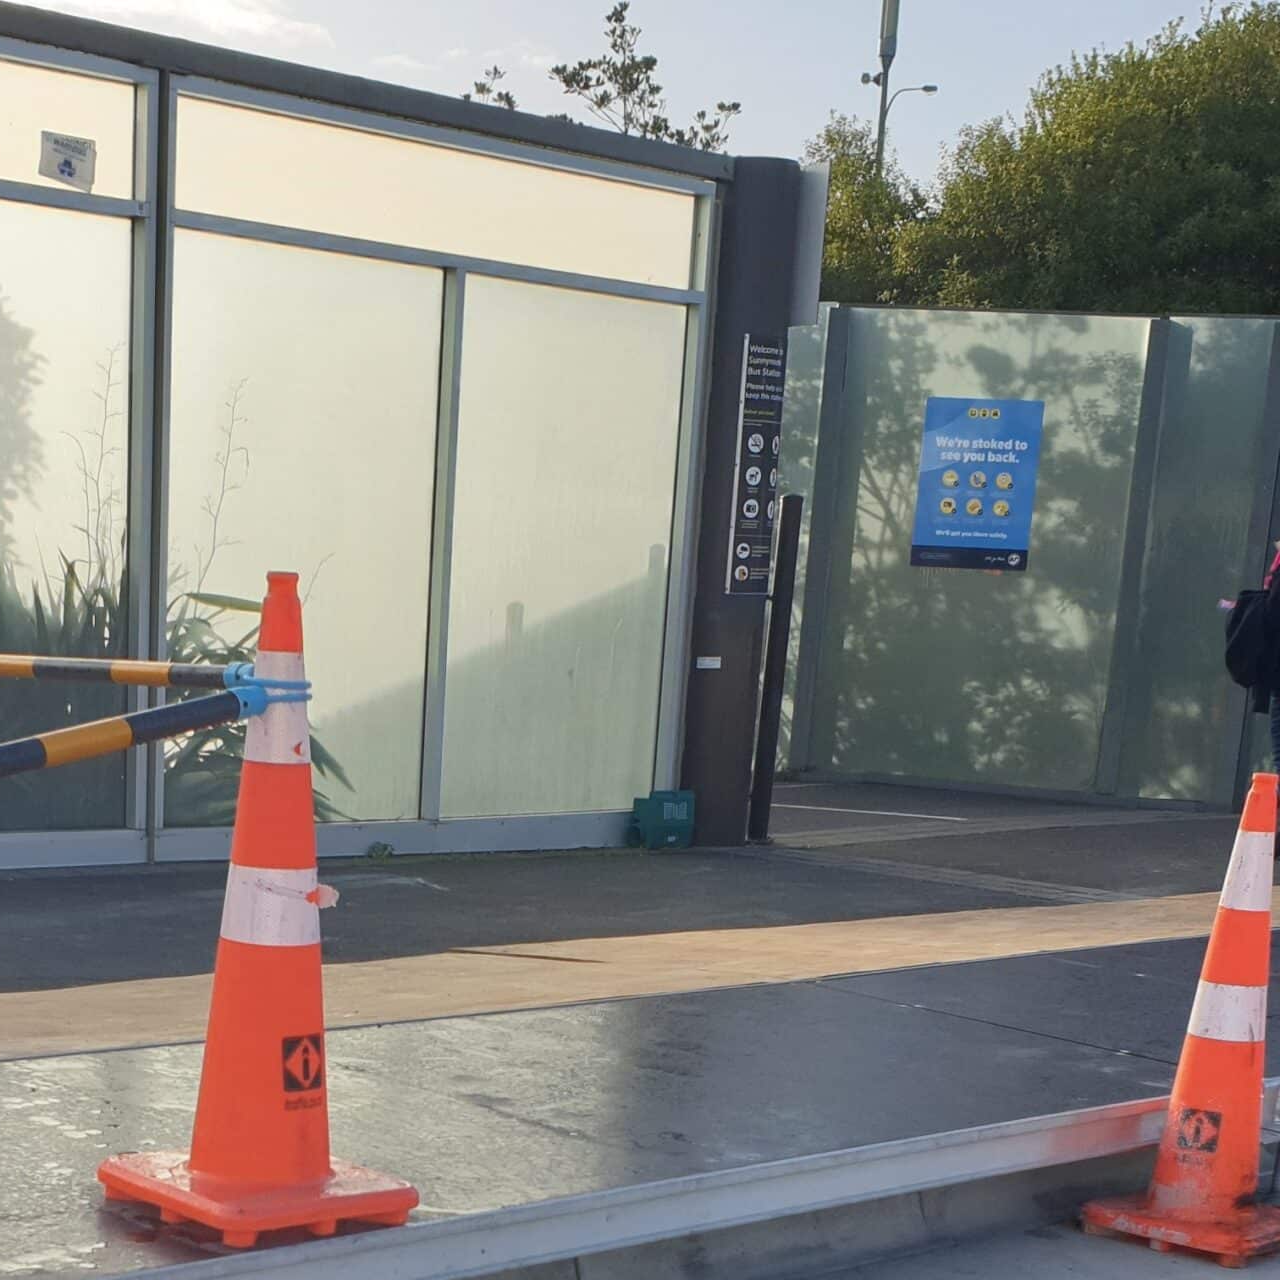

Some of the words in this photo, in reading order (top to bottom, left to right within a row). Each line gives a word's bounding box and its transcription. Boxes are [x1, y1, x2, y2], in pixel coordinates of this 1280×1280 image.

[936, 436, 970, 448] We're
[971, 437, 1013, 450] stoked
[1015, 440, 1028, 450] to
[940, 451, 961, 461] see
[963, 452, 985, 463] you
[987, 450, 1020, 464] back.
